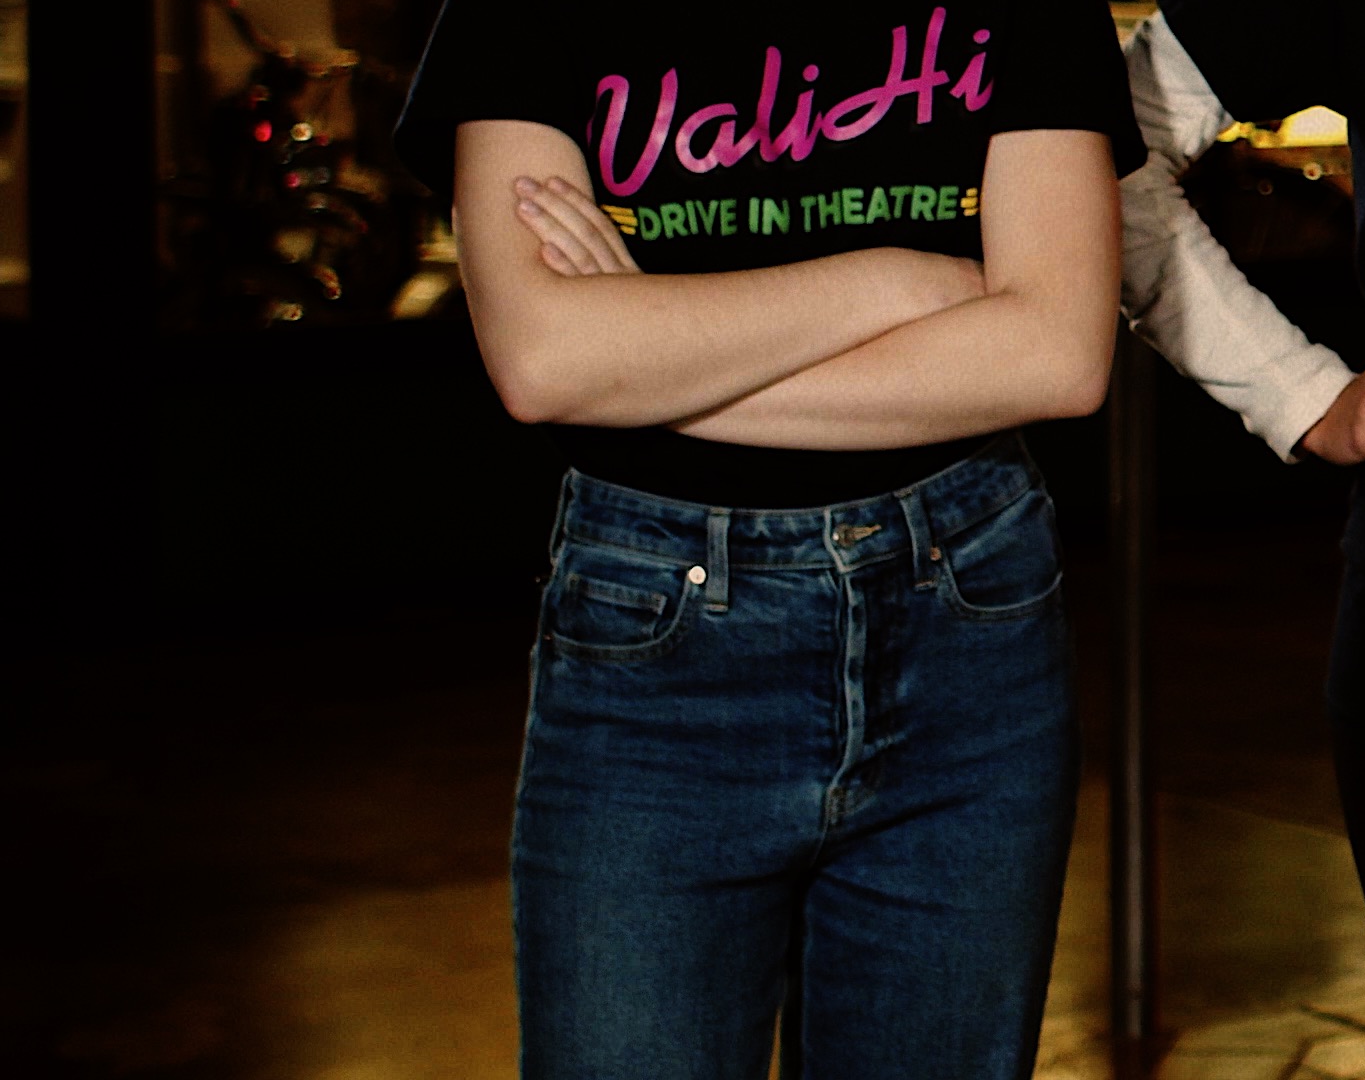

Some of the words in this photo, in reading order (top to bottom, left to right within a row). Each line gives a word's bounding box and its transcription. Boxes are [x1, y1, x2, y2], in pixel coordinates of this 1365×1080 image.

[638, 198, 737, 241] DRIVE
[748, 196, 790, 236] IN
[800, 184, 960, 233] THEATRE
